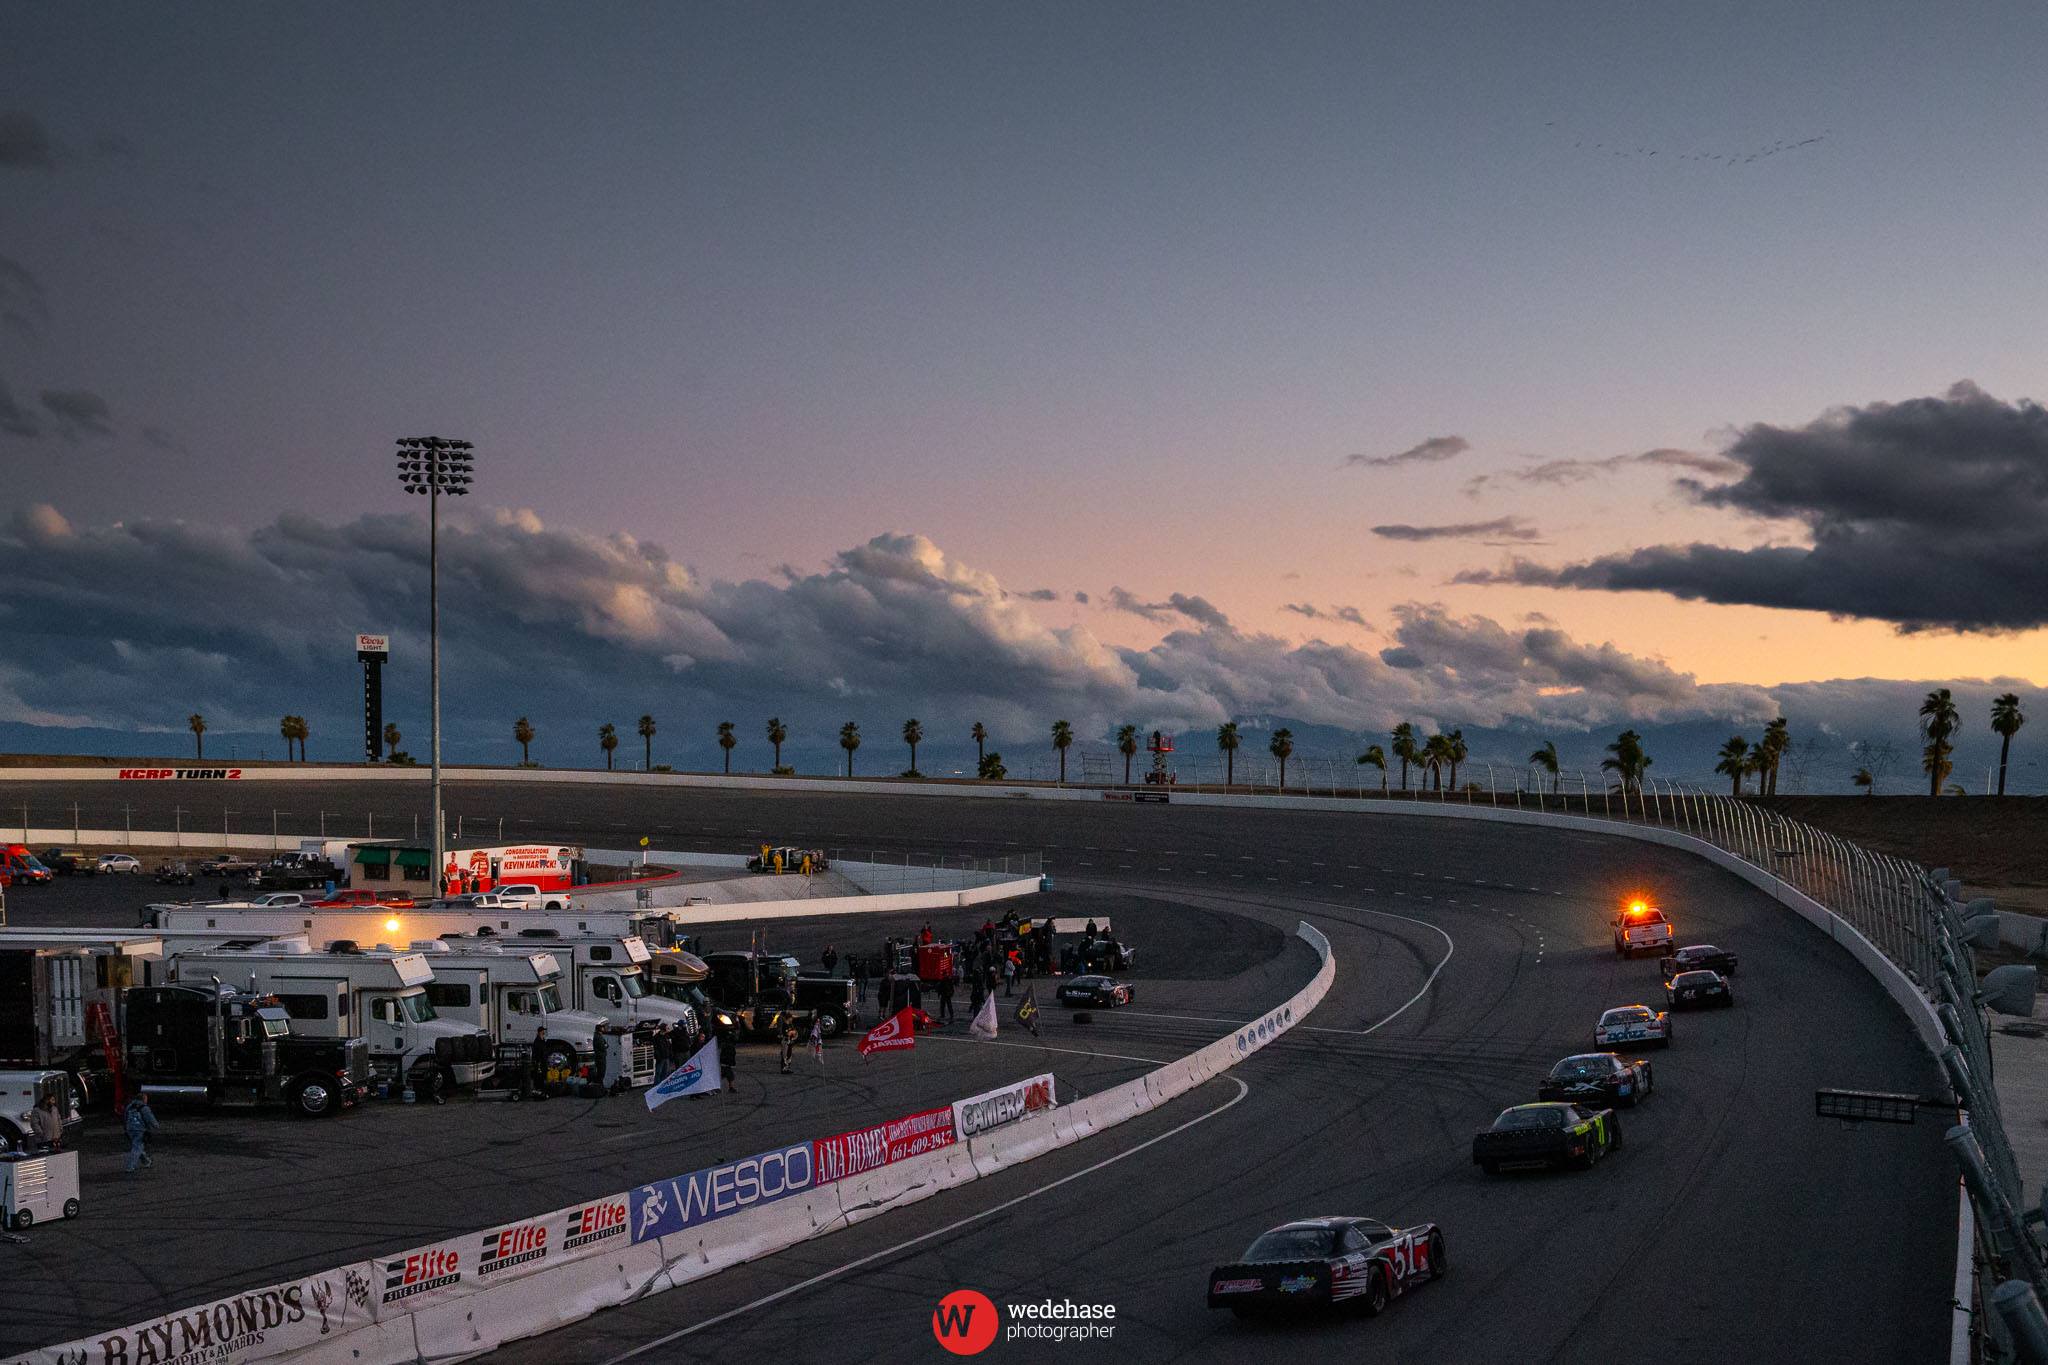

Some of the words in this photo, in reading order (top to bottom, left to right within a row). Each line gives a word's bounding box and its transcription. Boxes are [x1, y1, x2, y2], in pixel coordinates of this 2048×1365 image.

[361, 635, 385, 645] Coors
[119, 769, 173, 779] KCRP
[175, 769, 226, 779] TURN
[228, 769, 241, 779] 2
[504, 847, 549, 856] CONGRATULATIONS
[504, 860, 525, 870] KEVIN
[817, 1138, 846, 1183] AMA
[847, 1126, 889, 1173] HOMES
[672, 1146, 811, 1222] WESCO
[581, 1203, 626, 1235] Elite
[497, 1225, 547, 1258] Elite
[567, 1239, 585, 1249] SITE
[587, 1225, 623, 1243] SERVICES
[404, 1249, 459, 1285] Elite
[482, 1261, 501, 1274] SITE
[503, 1250, 543, 1267] SERVICES
[1393, 1233, 1418, 1280] 51
[388, 1288, 408, 1301] SITE
[410, 1276, 457, 1295] SERVICES
[98, 1286, 305, 1365] RAYMOND'S
[216, 1331, 264, 1358] AWARDS
